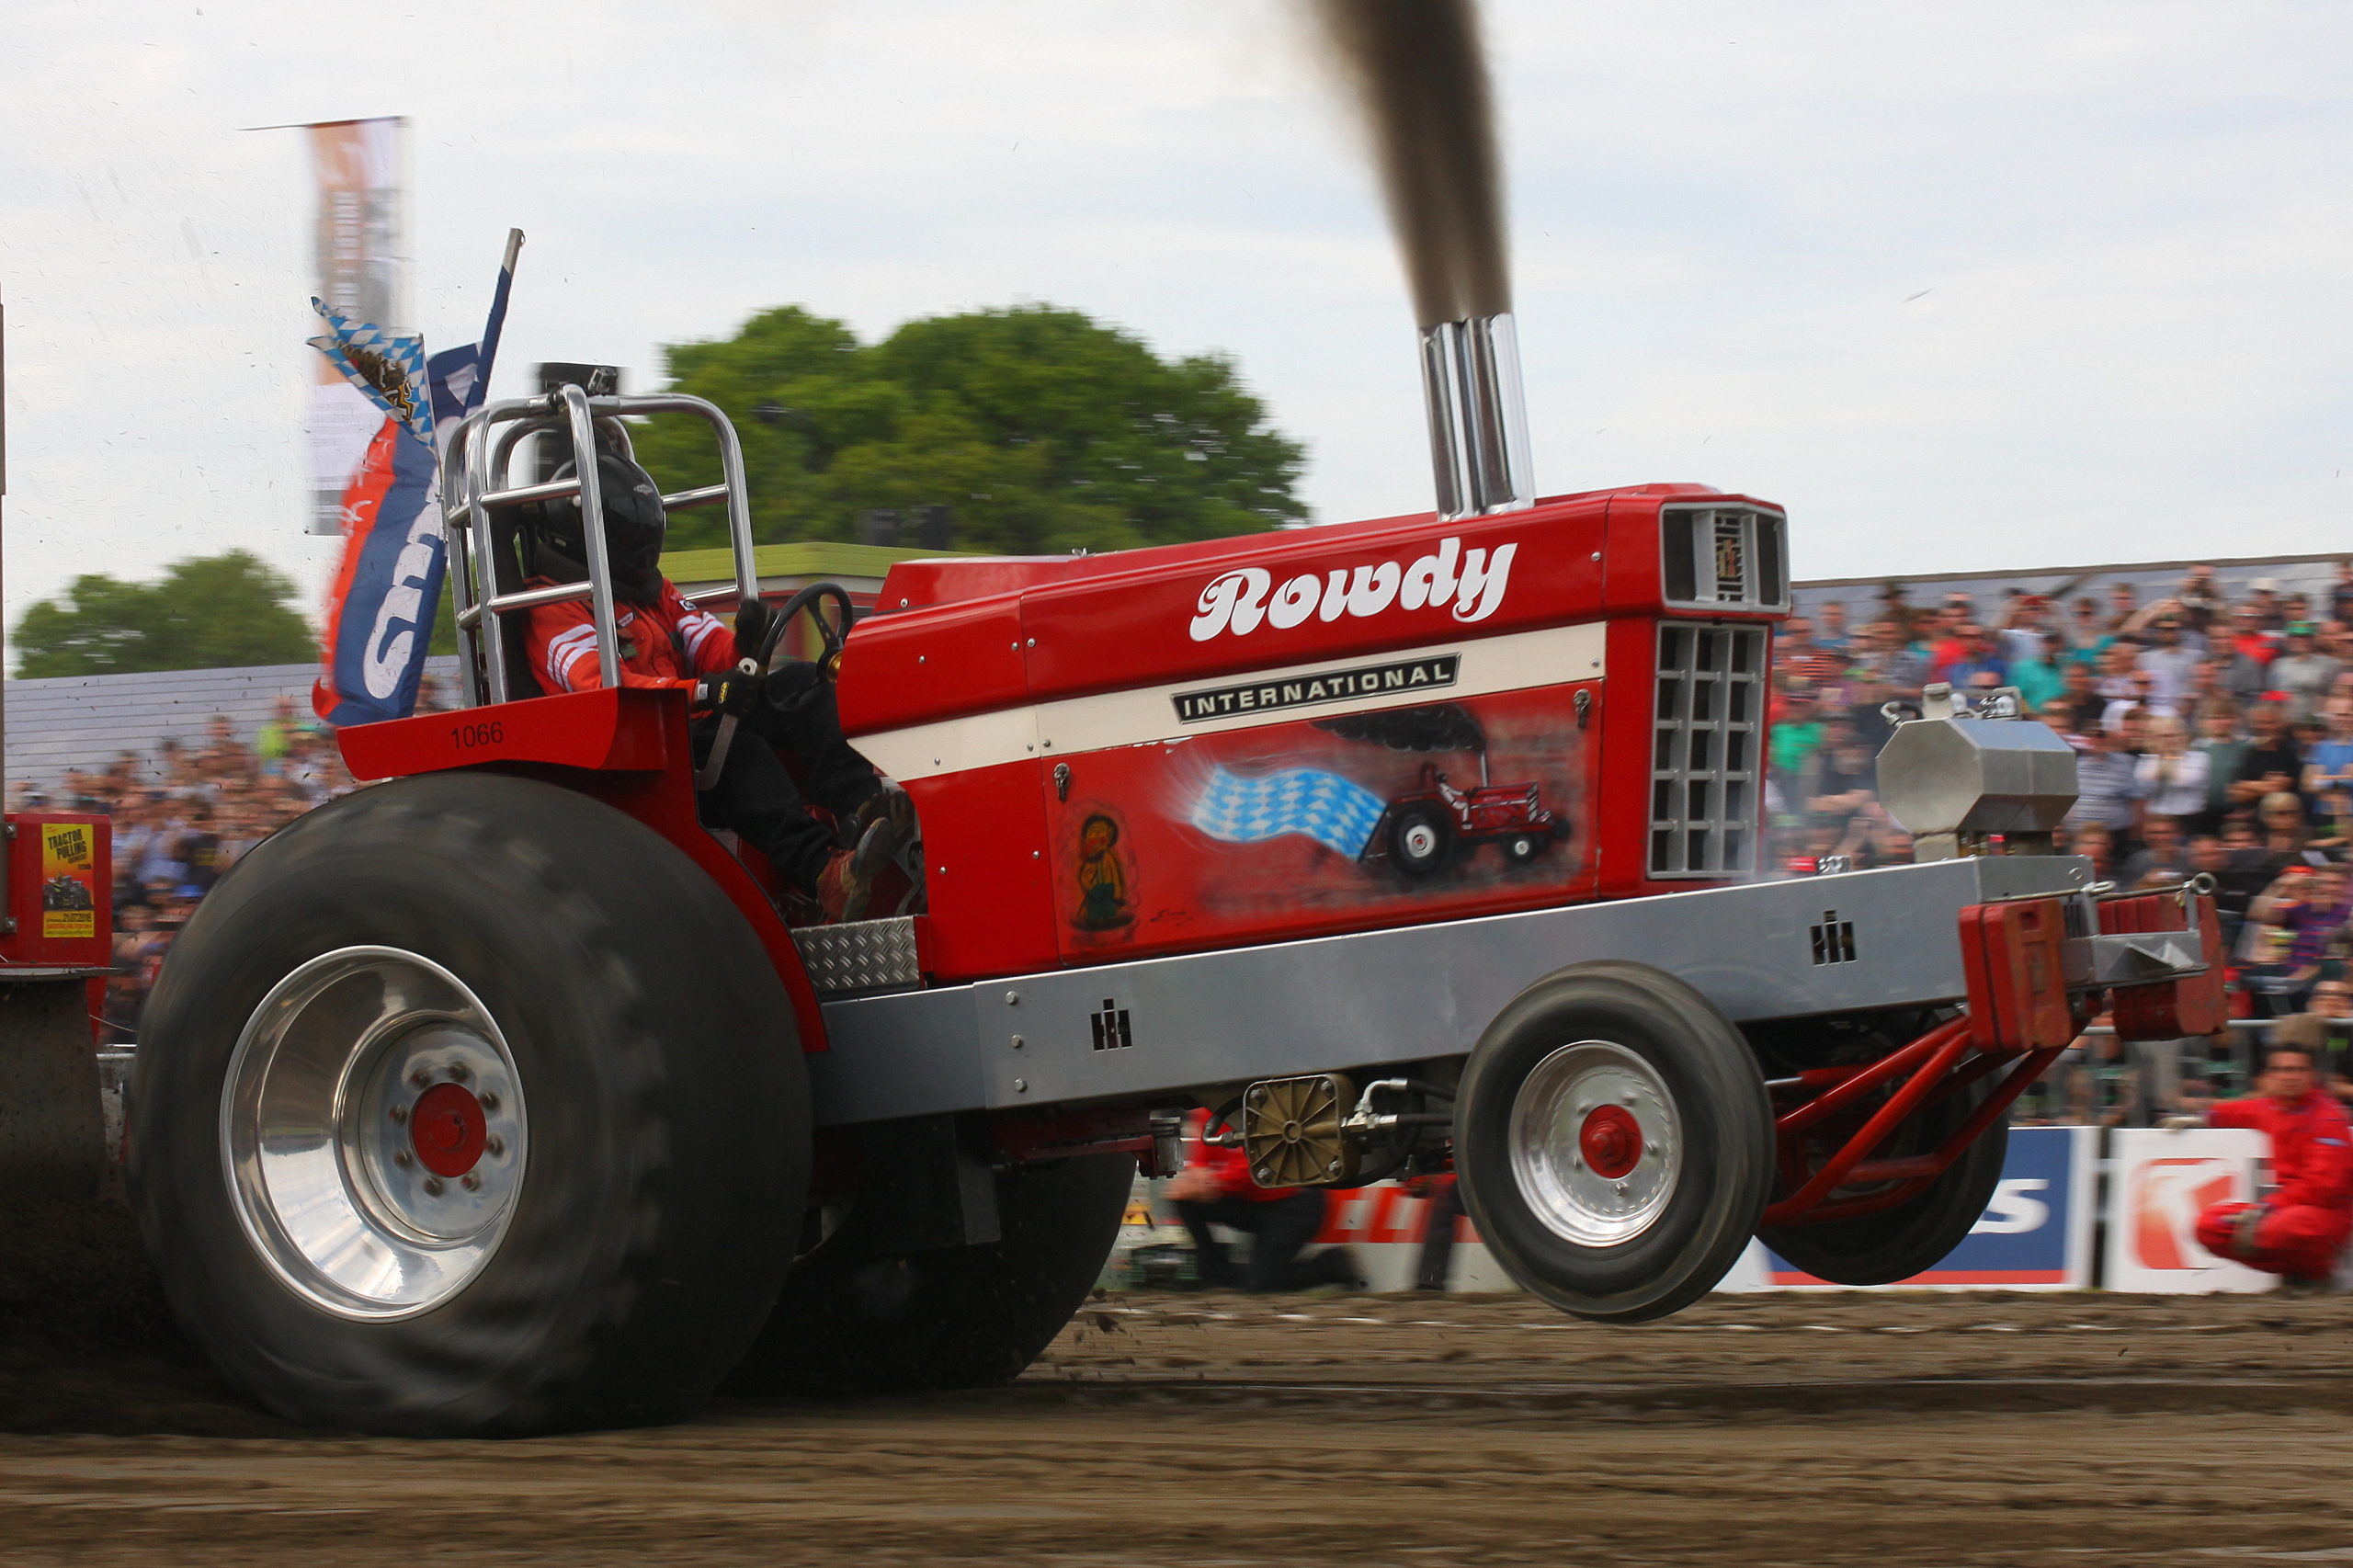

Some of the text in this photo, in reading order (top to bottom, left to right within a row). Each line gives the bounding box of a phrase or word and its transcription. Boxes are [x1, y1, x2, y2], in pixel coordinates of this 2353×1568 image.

[1189, 536, 1518, 642] Rowdy
[1184, 663, 1450, 717] INTERNATIONAL
[451, 722, 504, 749] 1066
[48, 829, 82, 849] TRACTOR
[57, 840, 87, 860] PULLING
